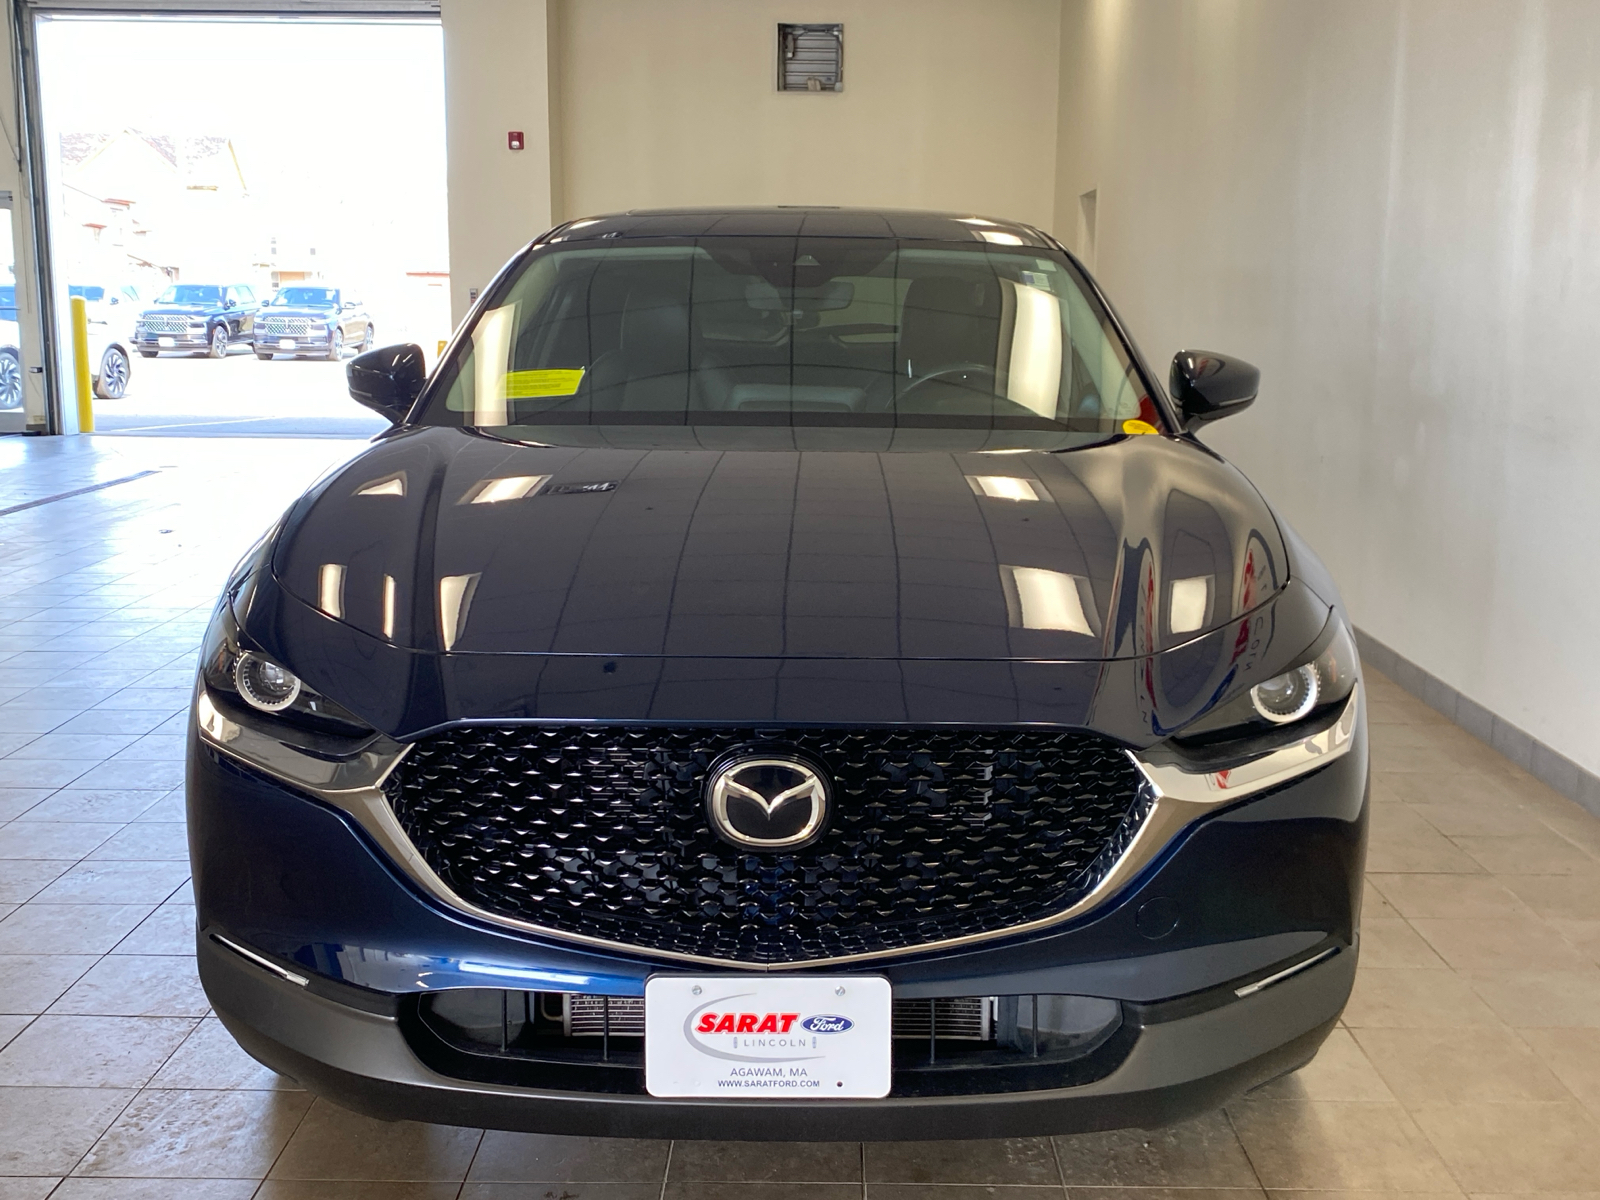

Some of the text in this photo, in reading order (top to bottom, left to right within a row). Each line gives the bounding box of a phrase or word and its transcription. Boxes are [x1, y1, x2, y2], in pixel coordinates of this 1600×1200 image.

[695, 1012, 845, 1034] SARAT Ford
[743, 1038, 806, 1047] LINCOLN
[730, 1067, 808, 1078] AGAWAM, MA
[717, 1079, 820, 1088] WWW.SARATFORD.COM
